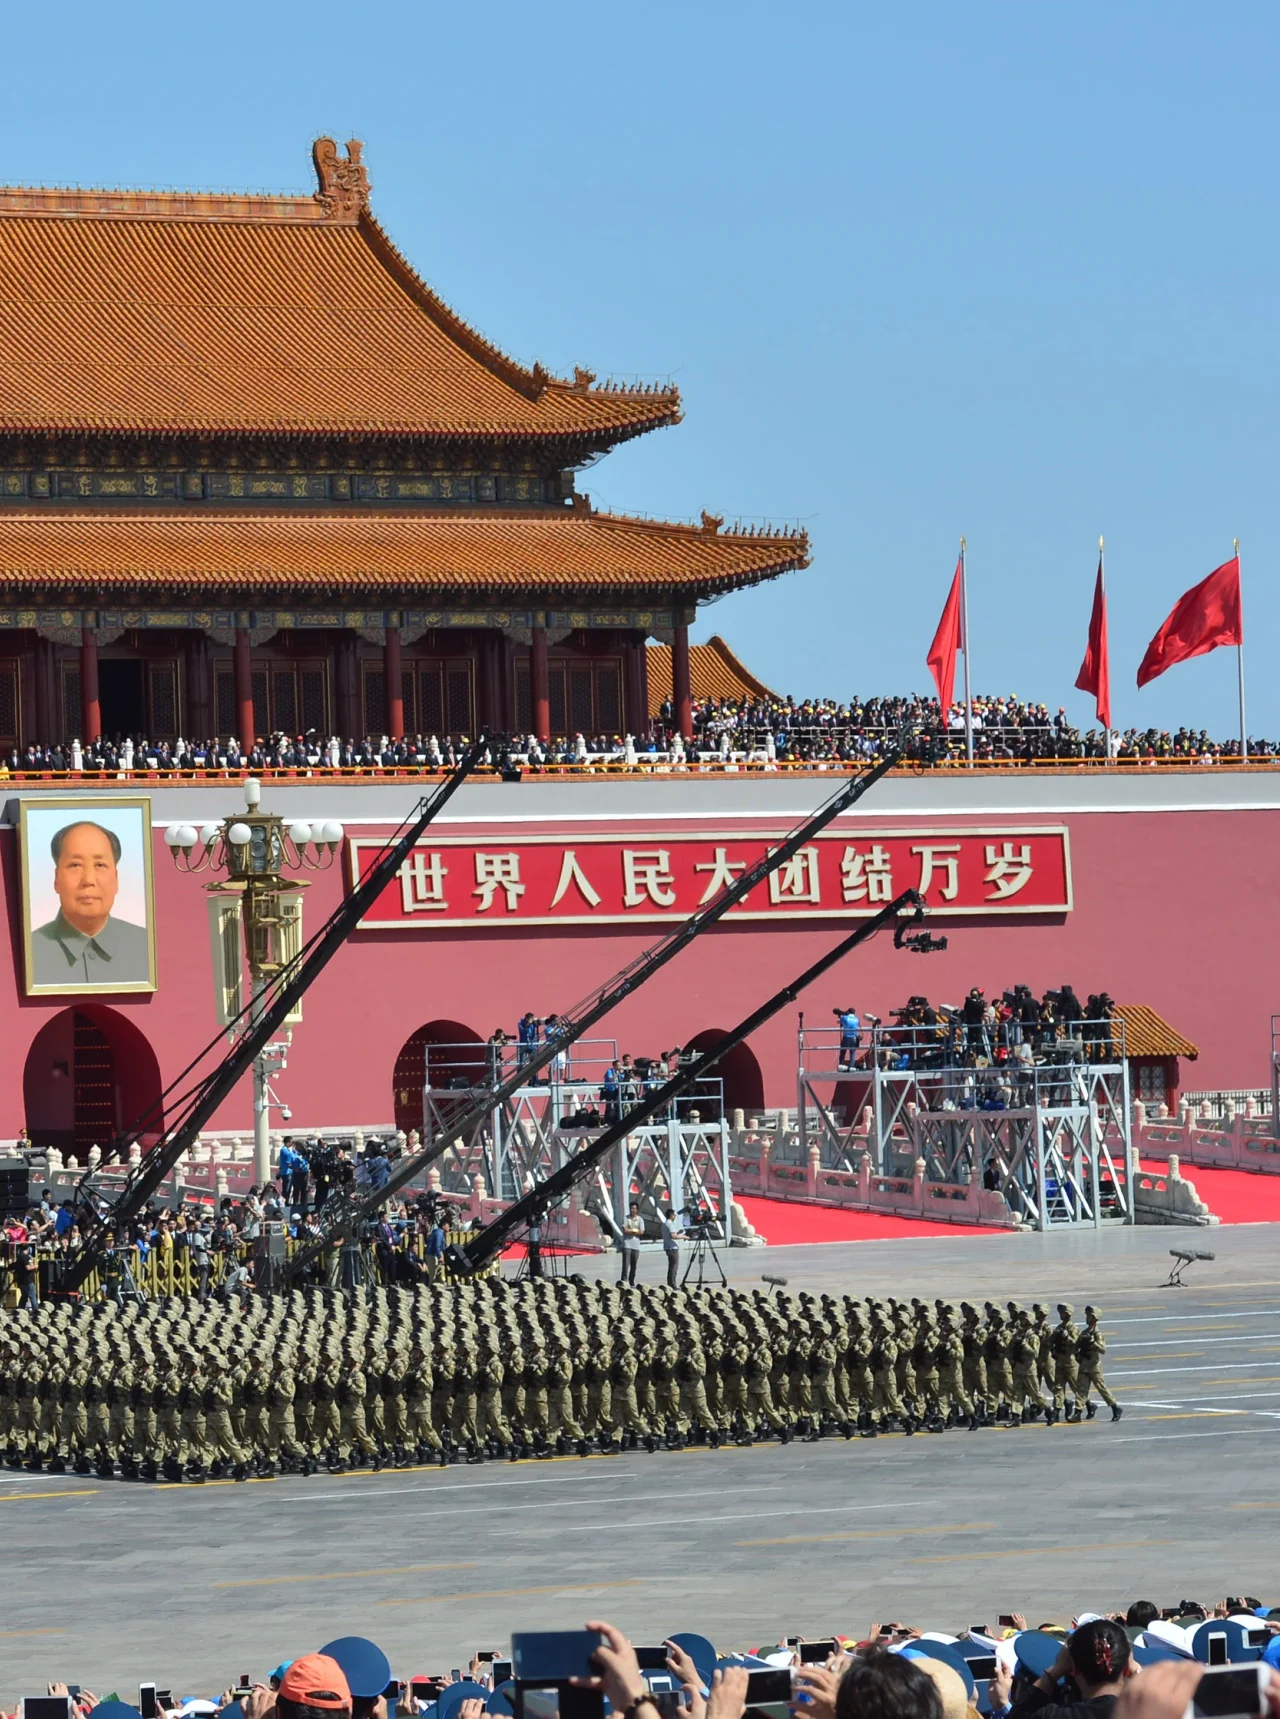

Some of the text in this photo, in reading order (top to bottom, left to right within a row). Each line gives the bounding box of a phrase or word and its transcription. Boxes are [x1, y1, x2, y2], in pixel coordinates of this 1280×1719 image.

[396, 842, 1033, 914] 世界人民大团结万岁
